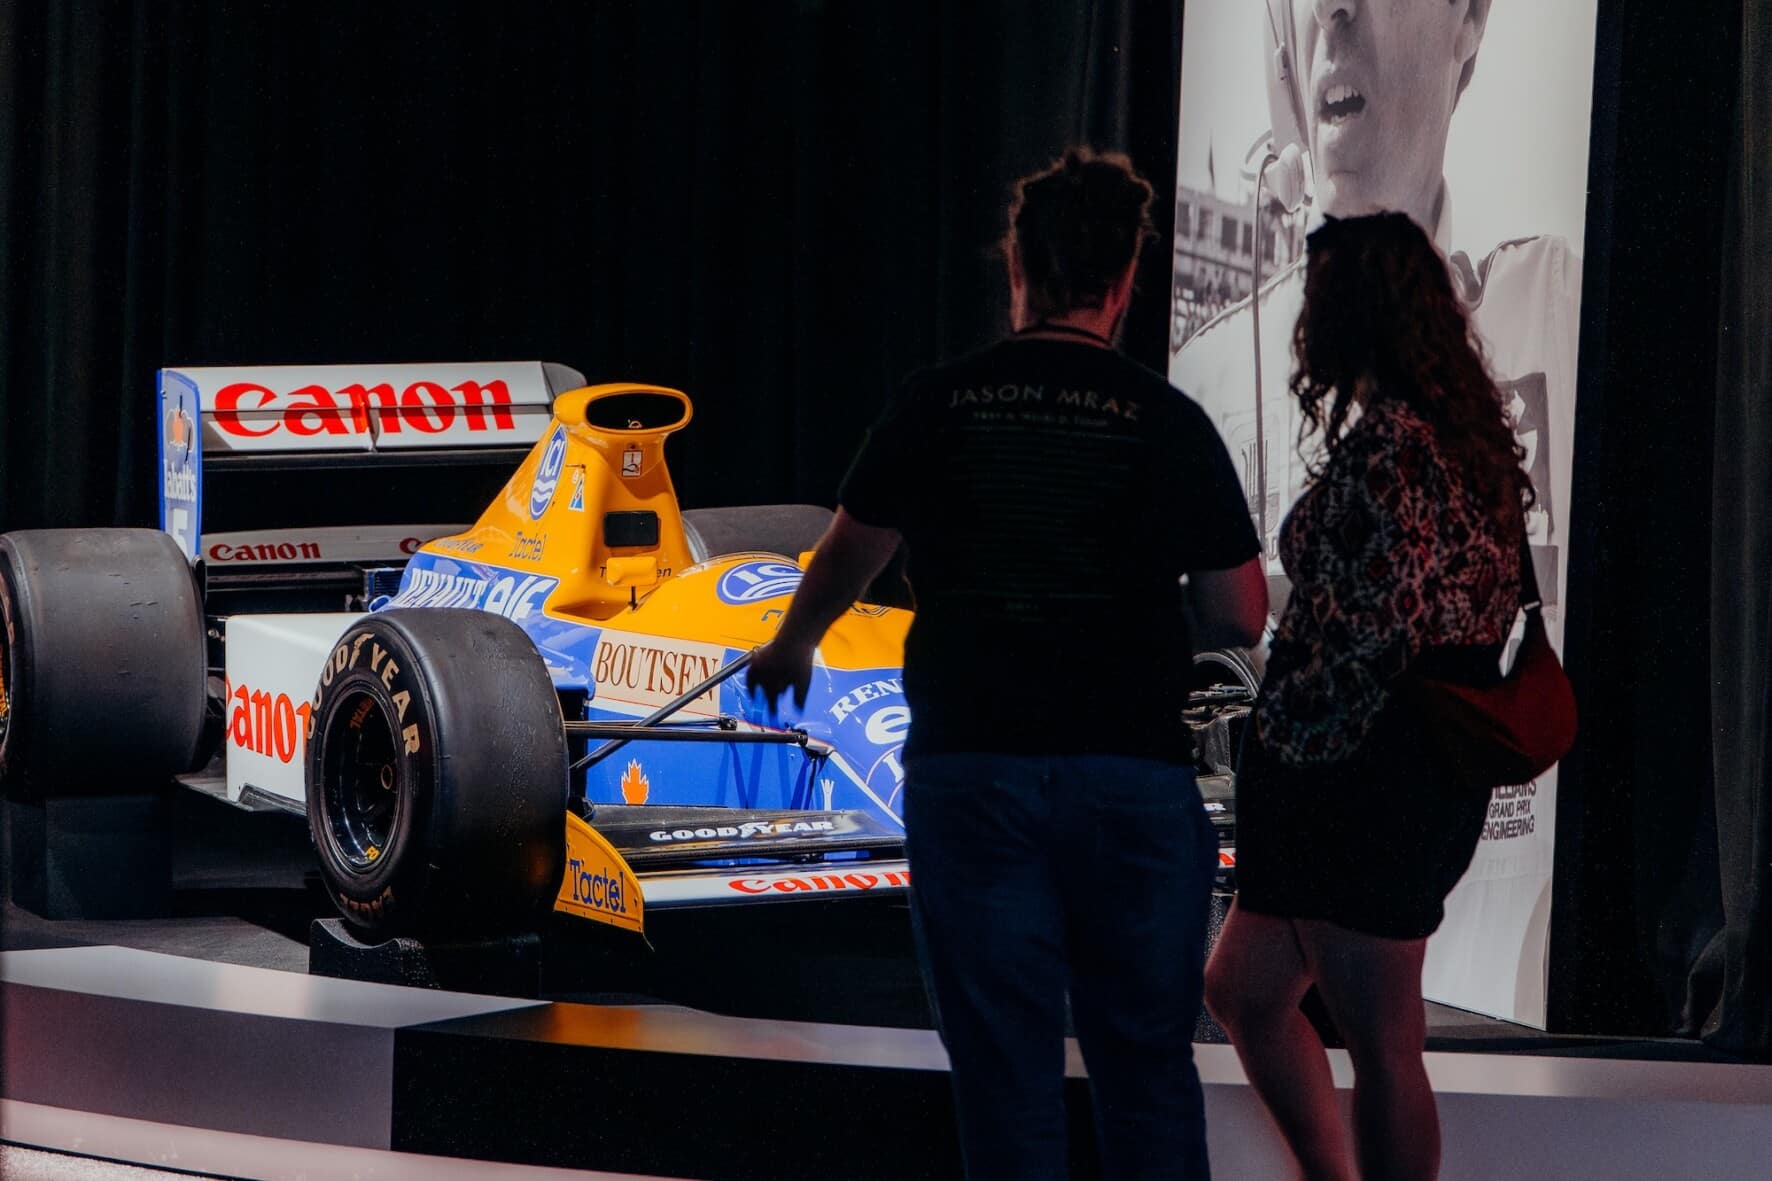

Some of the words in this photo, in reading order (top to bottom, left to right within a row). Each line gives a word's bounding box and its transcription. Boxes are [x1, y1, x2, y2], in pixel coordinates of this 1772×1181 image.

[215, 379, 515, 437] Canon
[949, 384, 1044, 408] JASON
[1057, 388, 1139, 421] MRAZ
[540, 438, 566, 478] ICI
[209, 540, 321, 561] Canon
[733, 563, 806, 585] IC
[595, 641, 719, 702] BOUTSEN
[1488, 801, 1515, 819] GRAND
[1516, 799, 1531, 817] PRIX
[650, 821, 834, 841] GOODYEAR
[1481, 814, 1535, 840] ENGINEERING
[570, 859, 626, 913] Tactel
